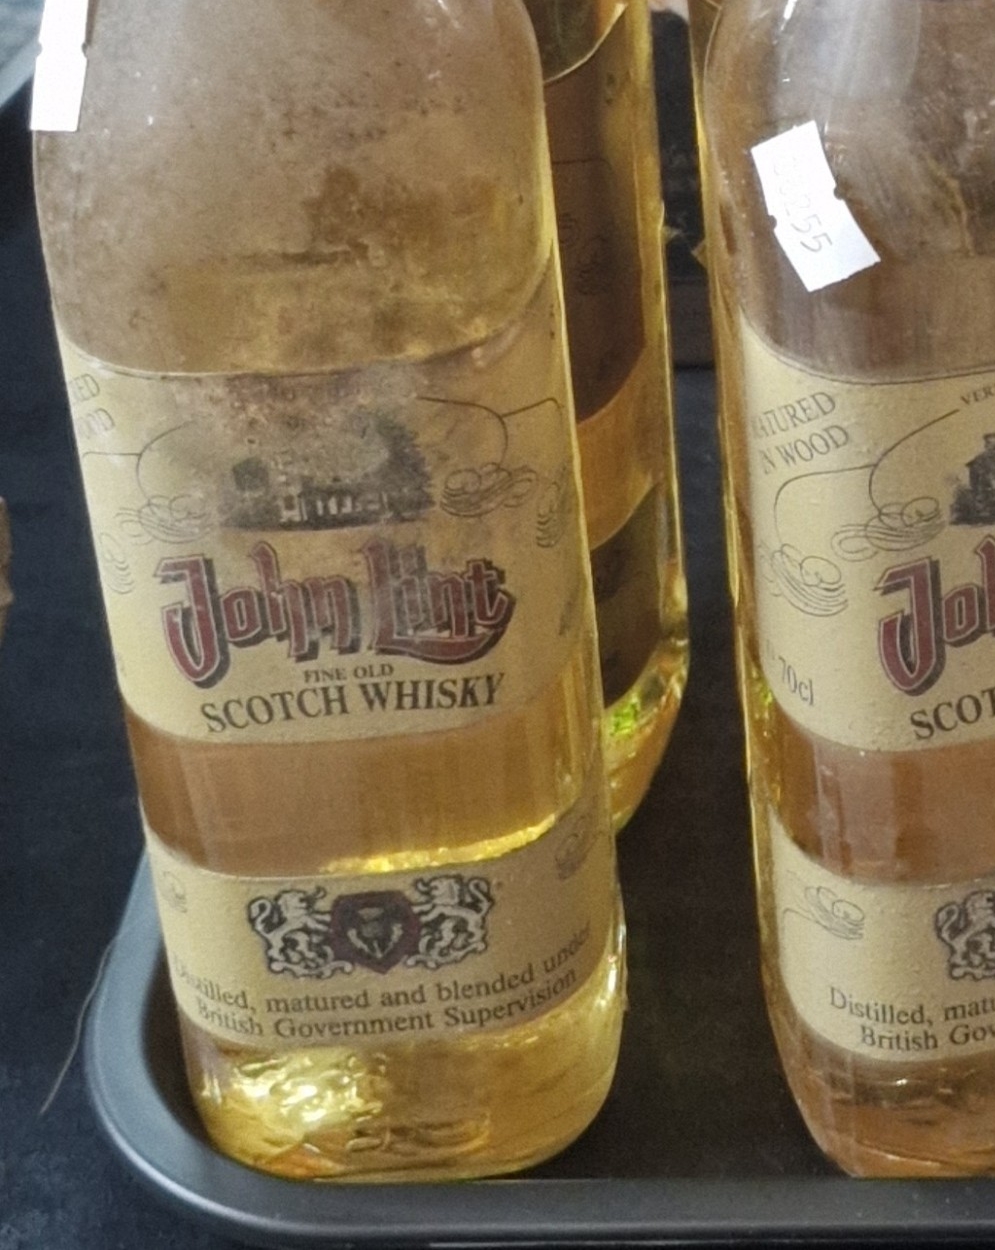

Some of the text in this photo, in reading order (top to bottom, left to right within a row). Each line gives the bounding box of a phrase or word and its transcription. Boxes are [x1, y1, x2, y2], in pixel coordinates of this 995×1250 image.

[153, 538, 516, 690] John Lint
[303, 662, 395, 684] FINE OLD
[778, 655, 814, 707] 70cl
[200, 671, 507, 735] SCOTCH WHISKY
[265, 986, 370, 1015] matured
[380, 983, 426, 1006] and
[436, 963, 535, 1004] blended
[272, 1010, 434, 1040] Government
[444, 967, 578, 1029] Supervision
[828, 984, 933, 1028] Distilled,
[860, 1024, 939, 1052] British
